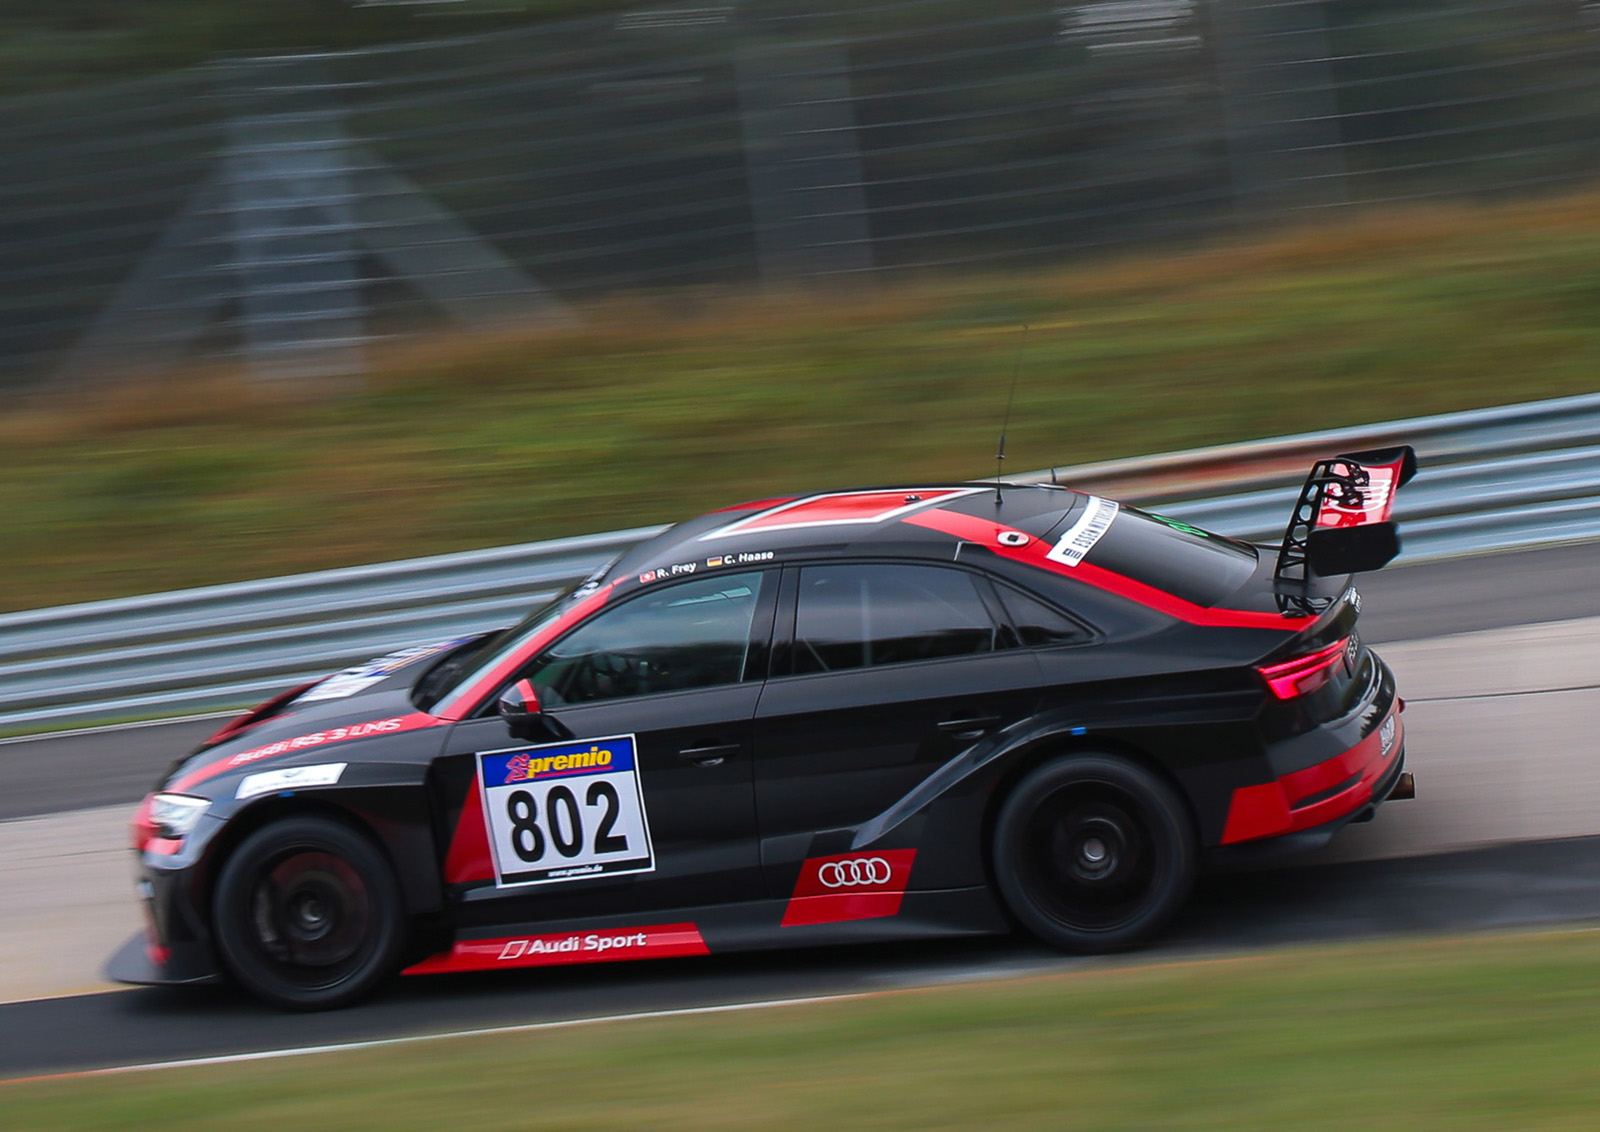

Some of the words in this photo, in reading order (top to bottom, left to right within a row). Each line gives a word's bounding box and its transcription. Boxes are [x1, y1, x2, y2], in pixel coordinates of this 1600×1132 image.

[724, 555, 736, 565] C.
[738, 551, 774, 563] Haase
[656, 568, 669, 578] R.
[671, 562, 697, 575] Frey
[289, 732, 327, 749] RS
[327, 728, 349, 740] 3
[527, 746, 612, 778] premio
[507, 780, 629, 863] 802
[527, 936, 580, 955] Audi
[583, 932, 647, 952] Sport
